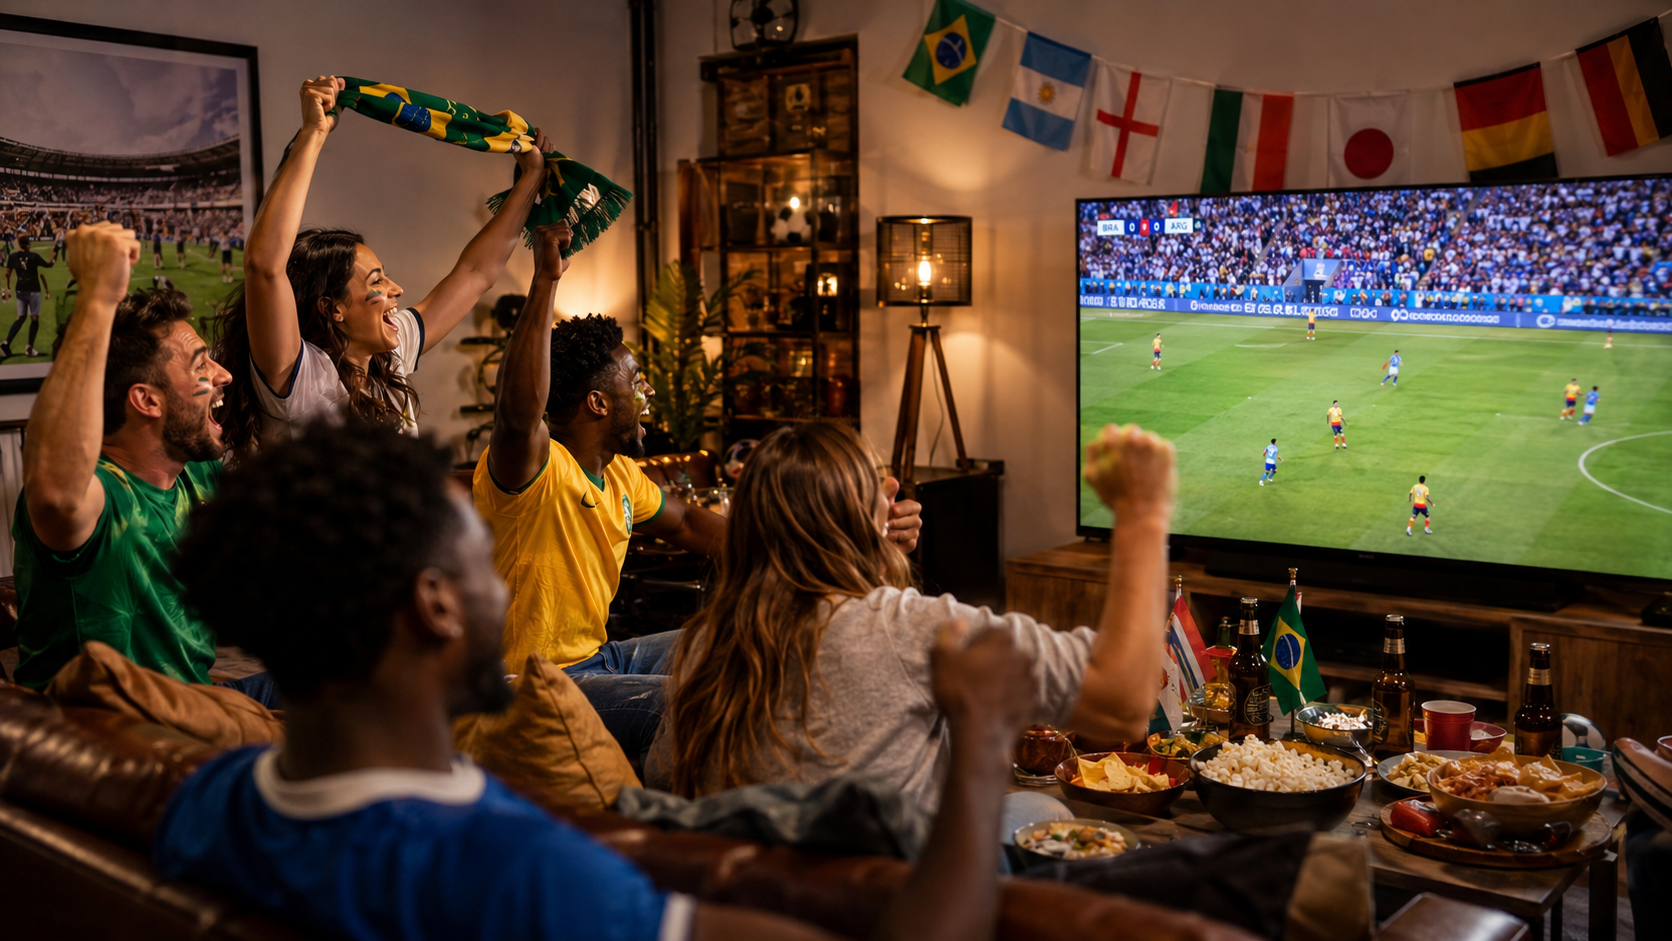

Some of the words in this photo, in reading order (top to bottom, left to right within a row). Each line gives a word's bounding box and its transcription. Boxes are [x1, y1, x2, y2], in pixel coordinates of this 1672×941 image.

[1102, 223, 1118, 232] BRA
[1129, 222, 1135, 232] 0
[1154, 221, 1160, 231] 0
[1171, 221, 1187, 230] ARG
